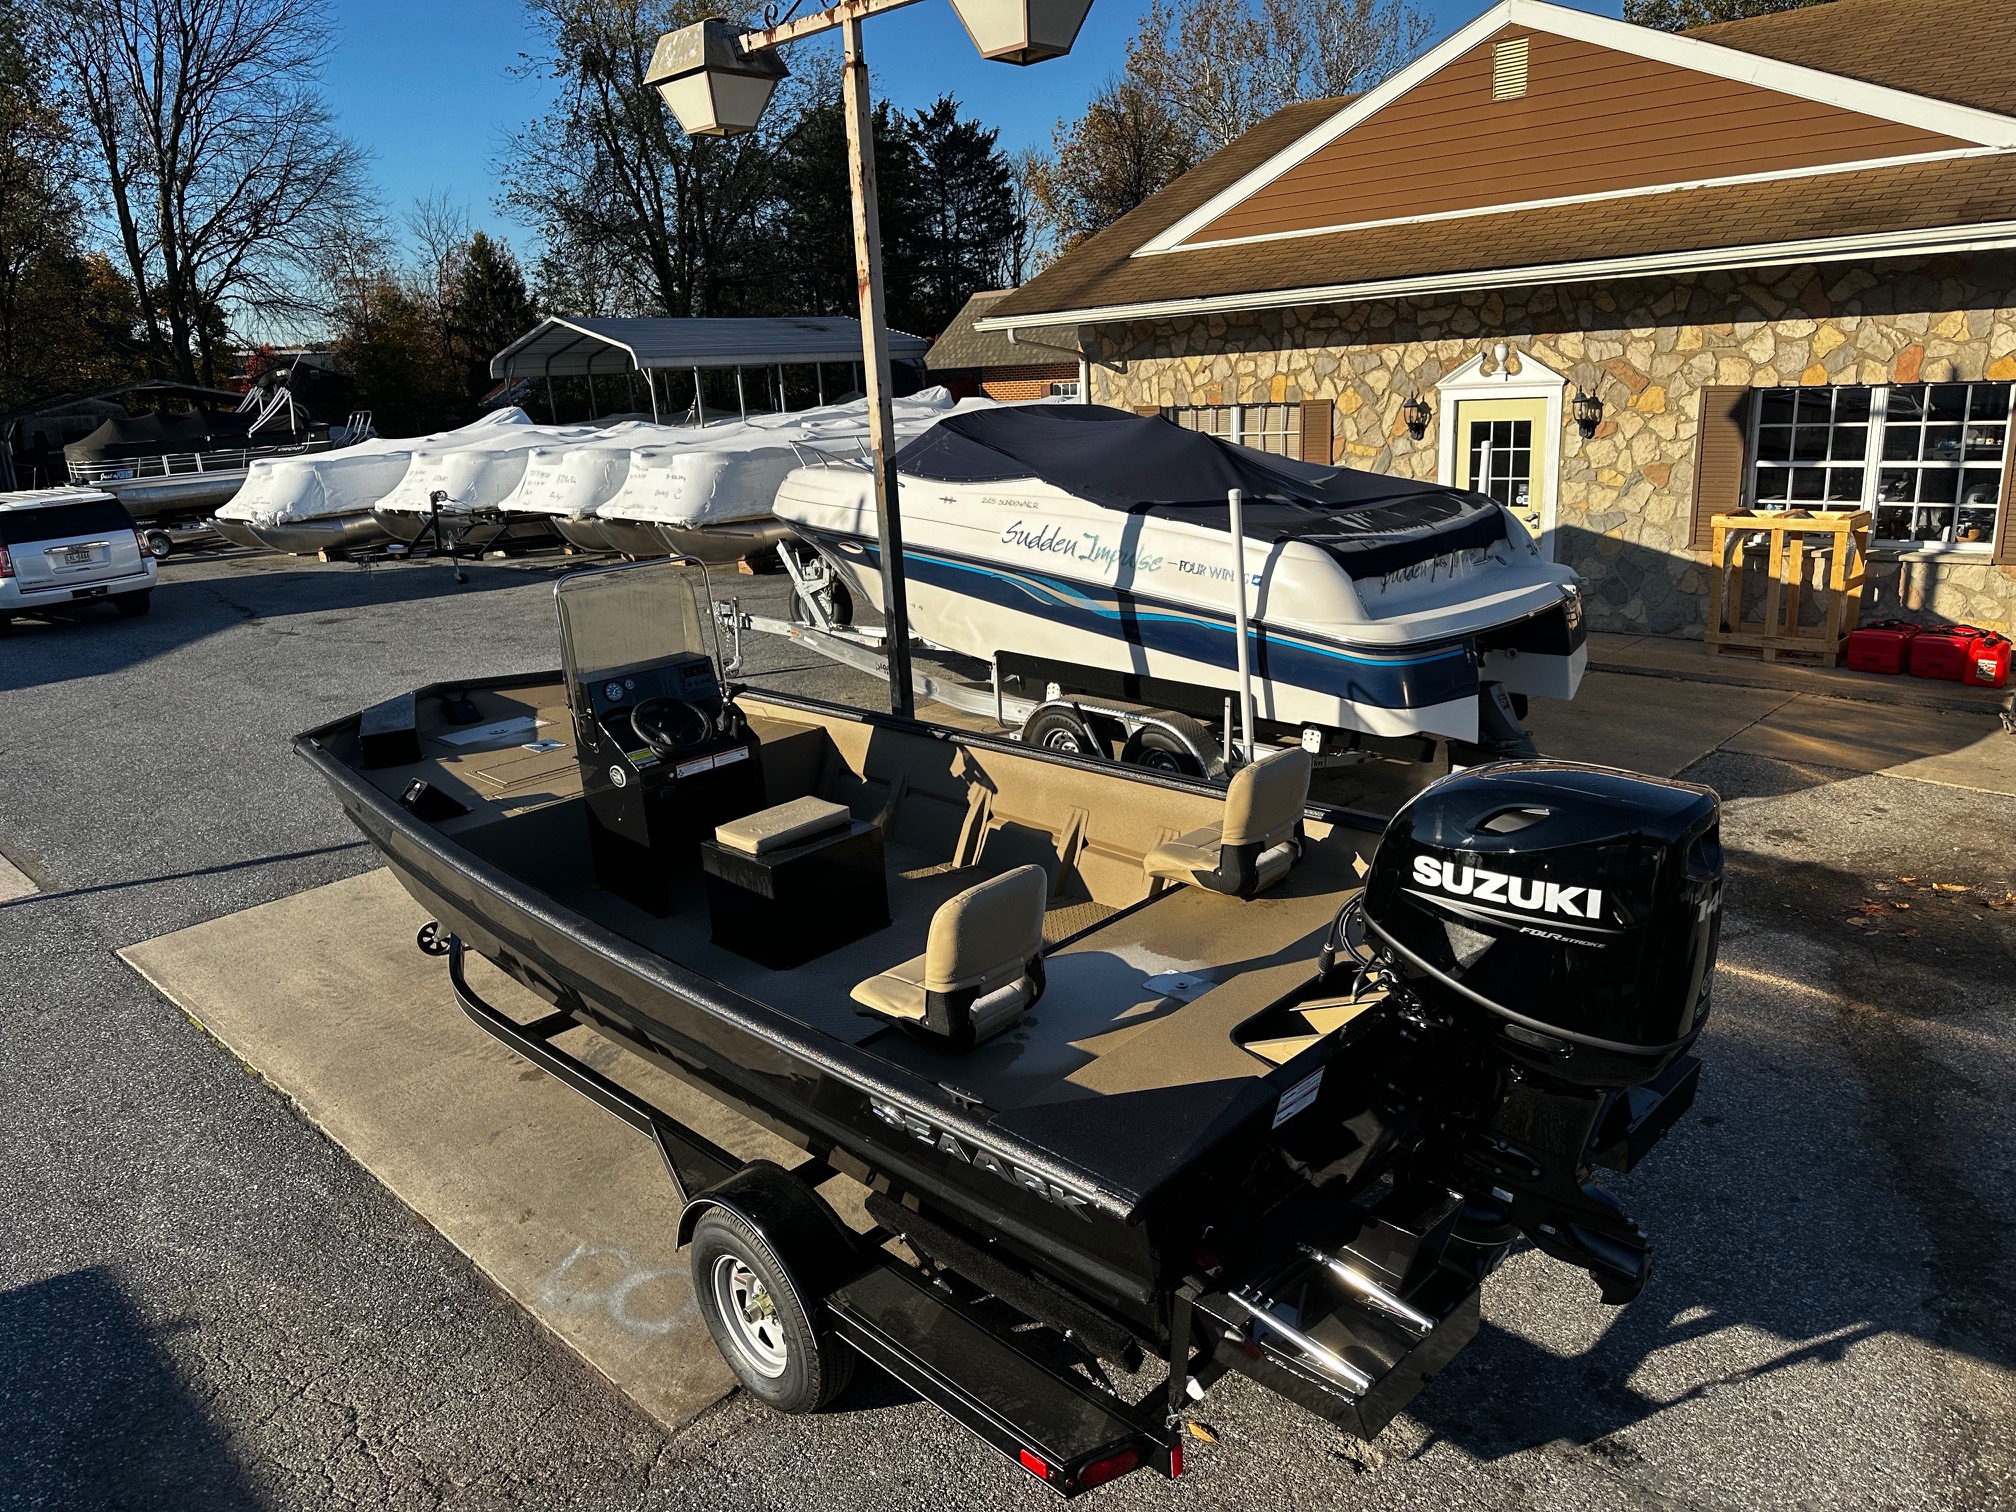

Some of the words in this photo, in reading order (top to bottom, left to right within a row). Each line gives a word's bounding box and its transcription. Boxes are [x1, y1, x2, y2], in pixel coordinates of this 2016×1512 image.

[997, 499, 1040, 509] SUNDOWNER
[1002, 520, 1078, 558] Sudden
[1078, 532, 1163, 574] Impulse
[1178, 560, 1207, 577] FOUR
[1208, 565, 1250, 584] WINS
[1412, 855, 1603, 920] SUZUKI
[1560, 936, 1608, 949] STROKE
